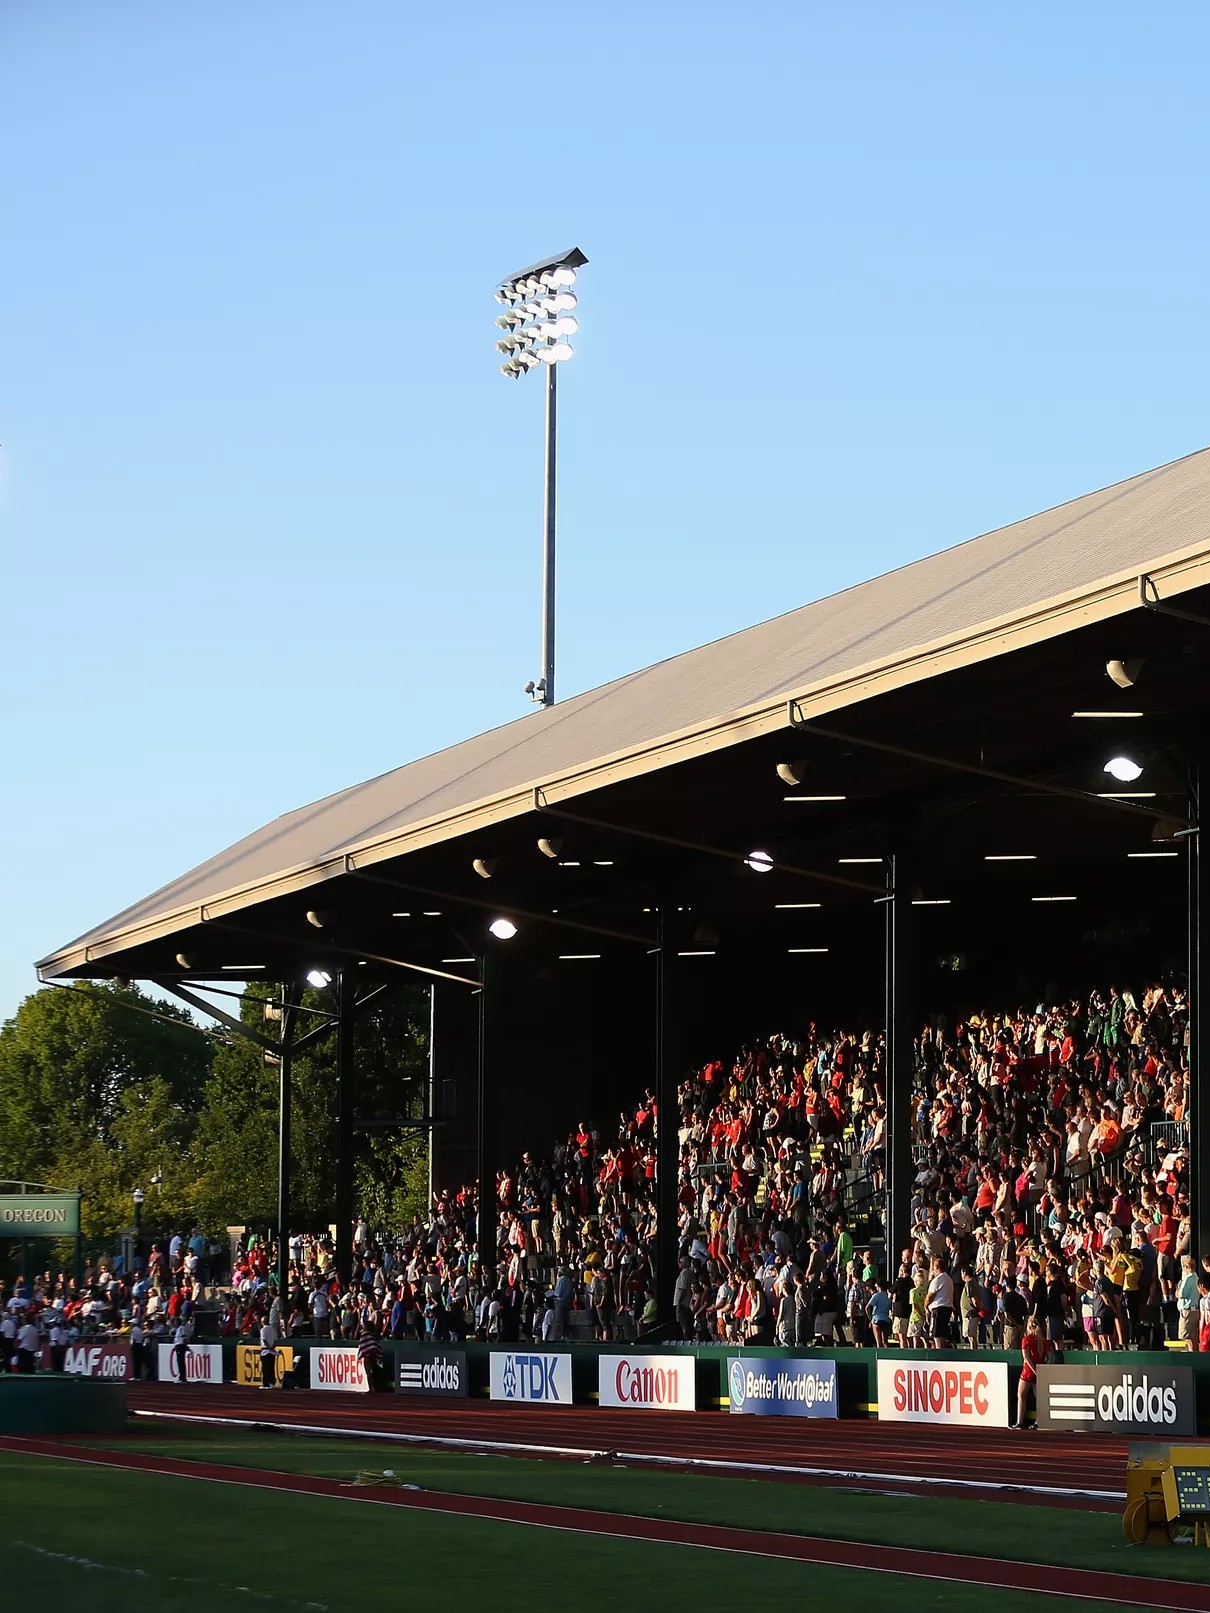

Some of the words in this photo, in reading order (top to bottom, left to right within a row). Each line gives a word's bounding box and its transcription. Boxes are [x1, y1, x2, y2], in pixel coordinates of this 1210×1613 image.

[4, 1208, 66, 1223] OREGON
[169, 1346, 212, 1379] Cnon
[318, 1353, 363, 1385] SINOPEC
[422, 1356, 460, 1390] adidas
[515, 1355, 560, 1401] TDK
[616, 1359, 679, 1404] Canon
[893, 1368, 989, 1416] SINOPEC
[1097, 1374, 1177, 1424] adidas
